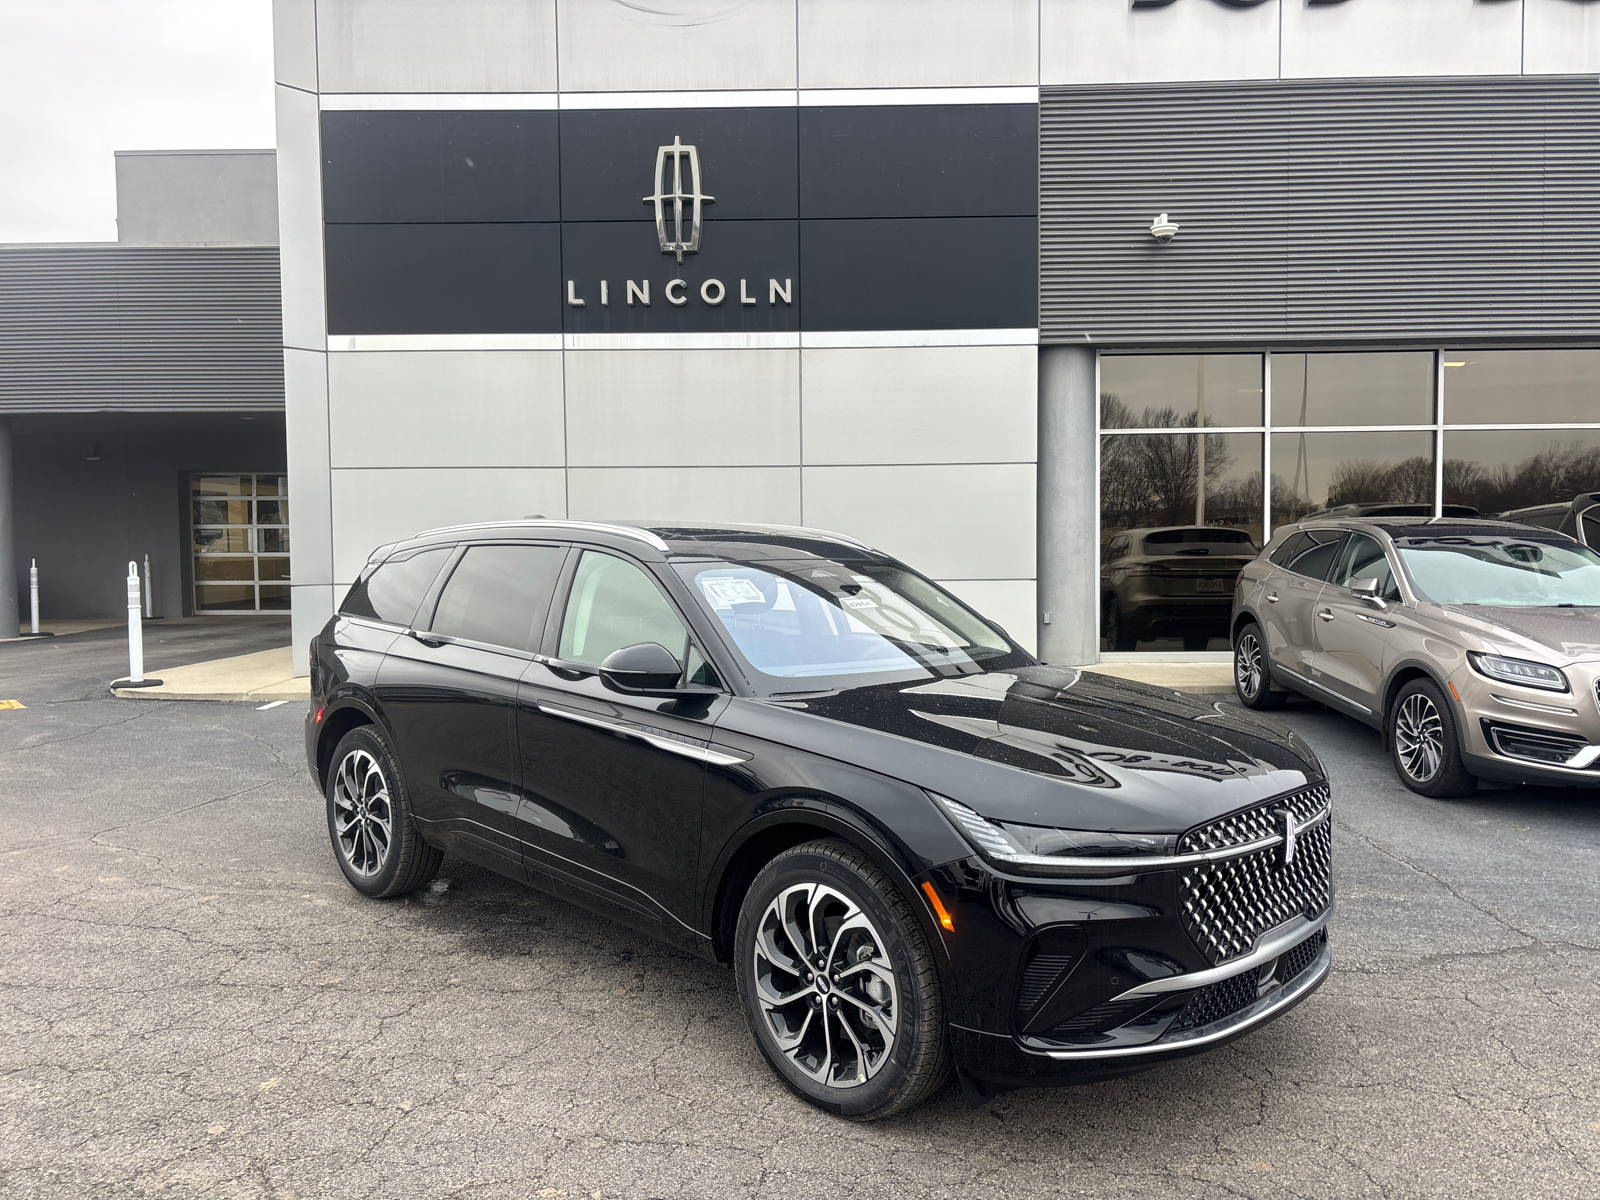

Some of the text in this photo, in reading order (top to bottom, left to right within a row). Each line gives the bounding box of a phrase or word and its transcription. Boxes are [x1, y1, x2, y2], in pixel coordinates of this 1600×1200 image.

[567, 278, 792, 306] LINCOLN
[640, 725, 706, 749] NAUTILUS
[386, 779, 397, 836] MICHELIN
[897, 973, 914, 1066] MICHELIN
